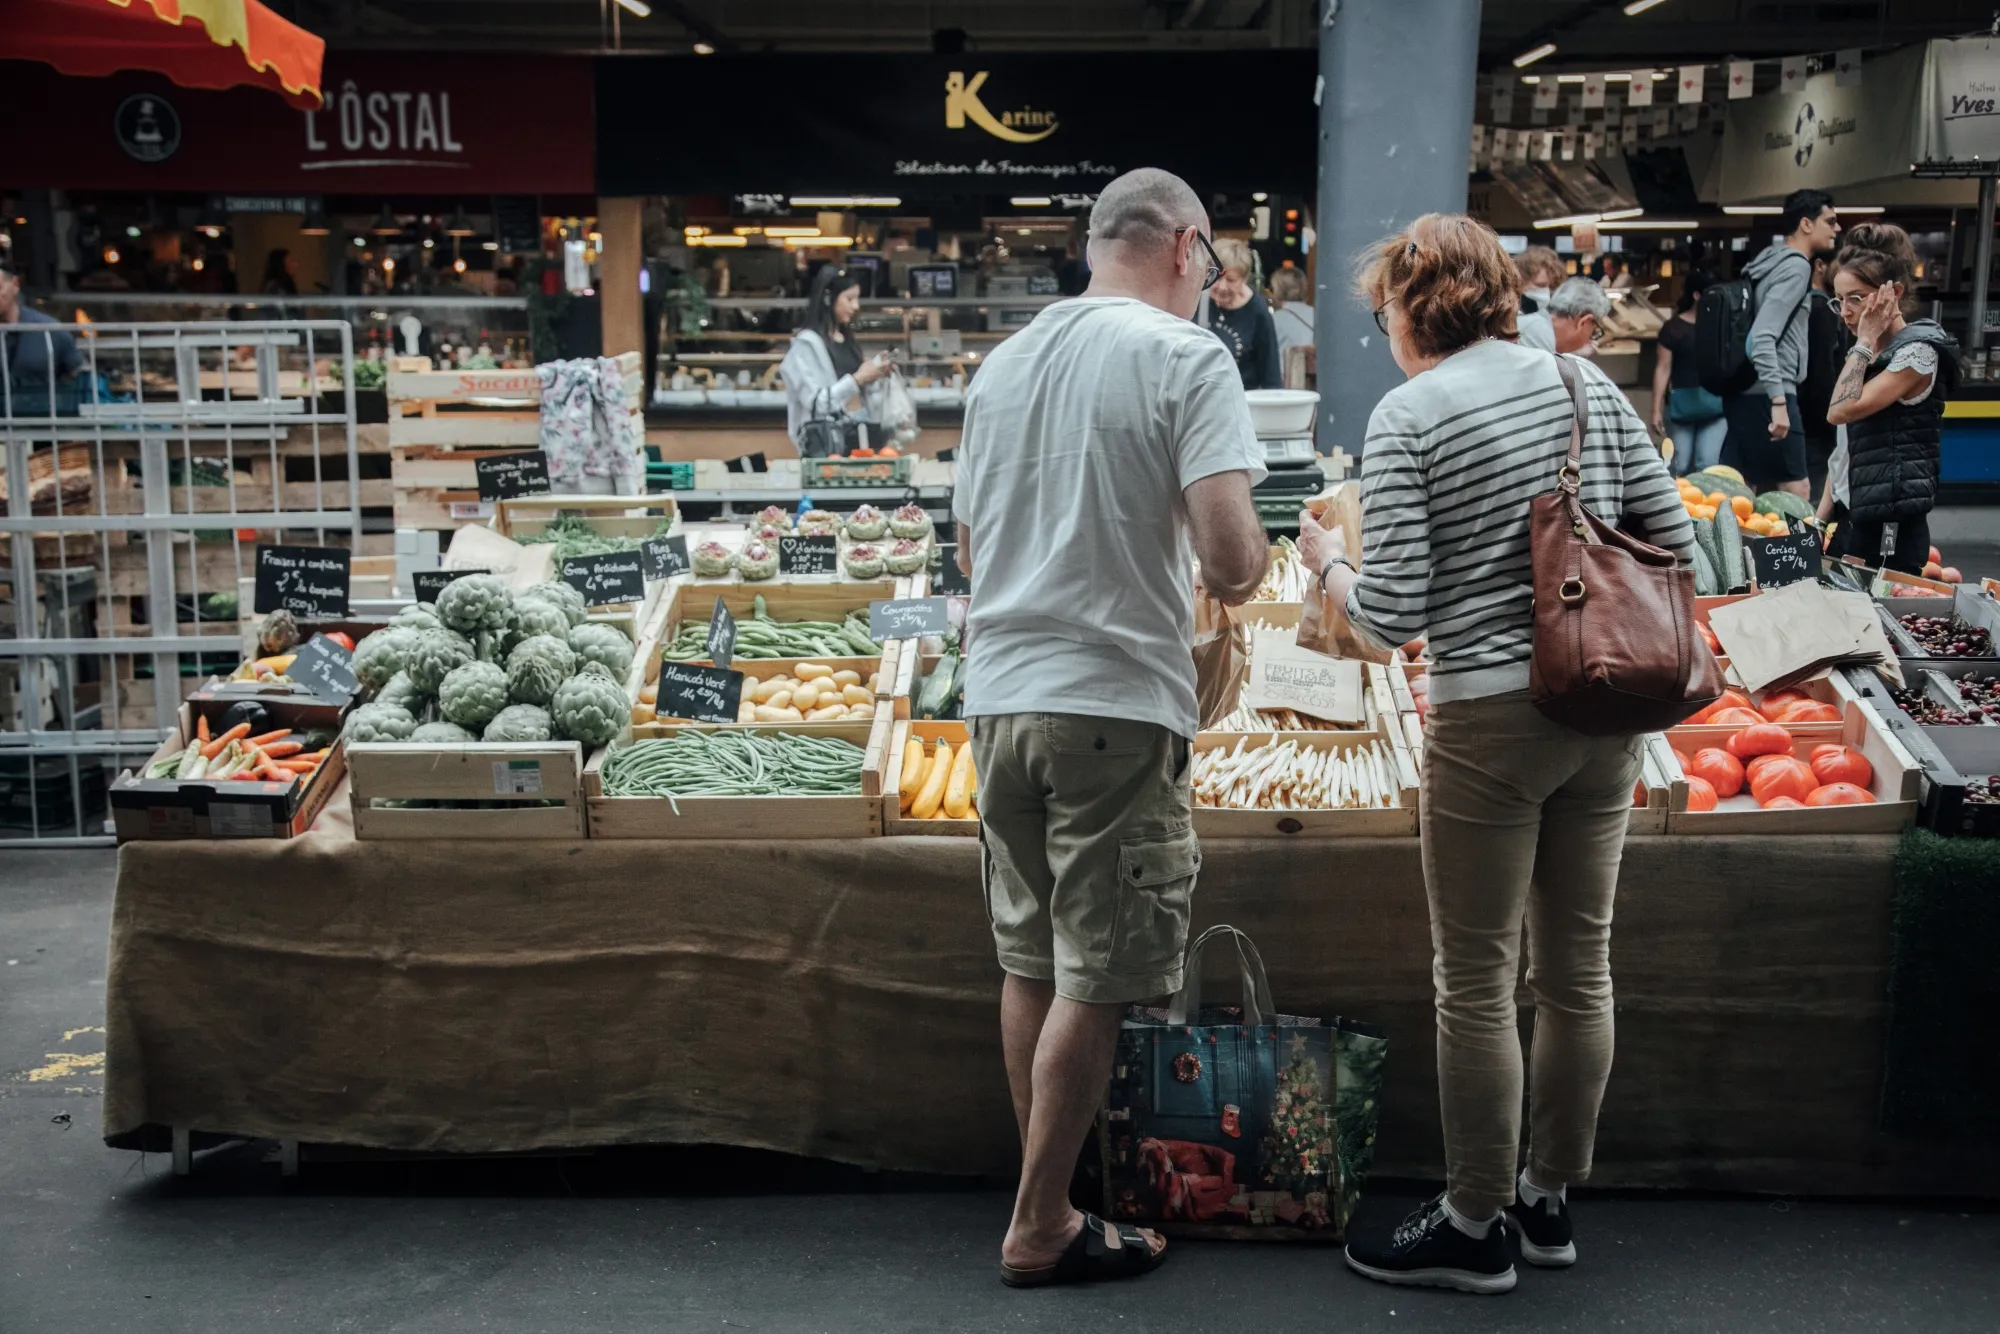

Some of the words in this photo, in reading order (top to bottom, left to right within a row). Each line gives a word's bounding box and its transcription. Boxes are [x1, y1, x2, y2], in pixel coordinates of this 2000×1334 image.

[945, 71, 1060, 143] Karine
[1951, 95, 1995, 114] Yves
[306, 79, 463, 152] L'ÔSTAL
[974, 158, 998, 175] de
[1765, 543, 1798, 555] Cerises
[564, 562, 589, 577] Gros
[665, 666, 705, 685] Haricots
